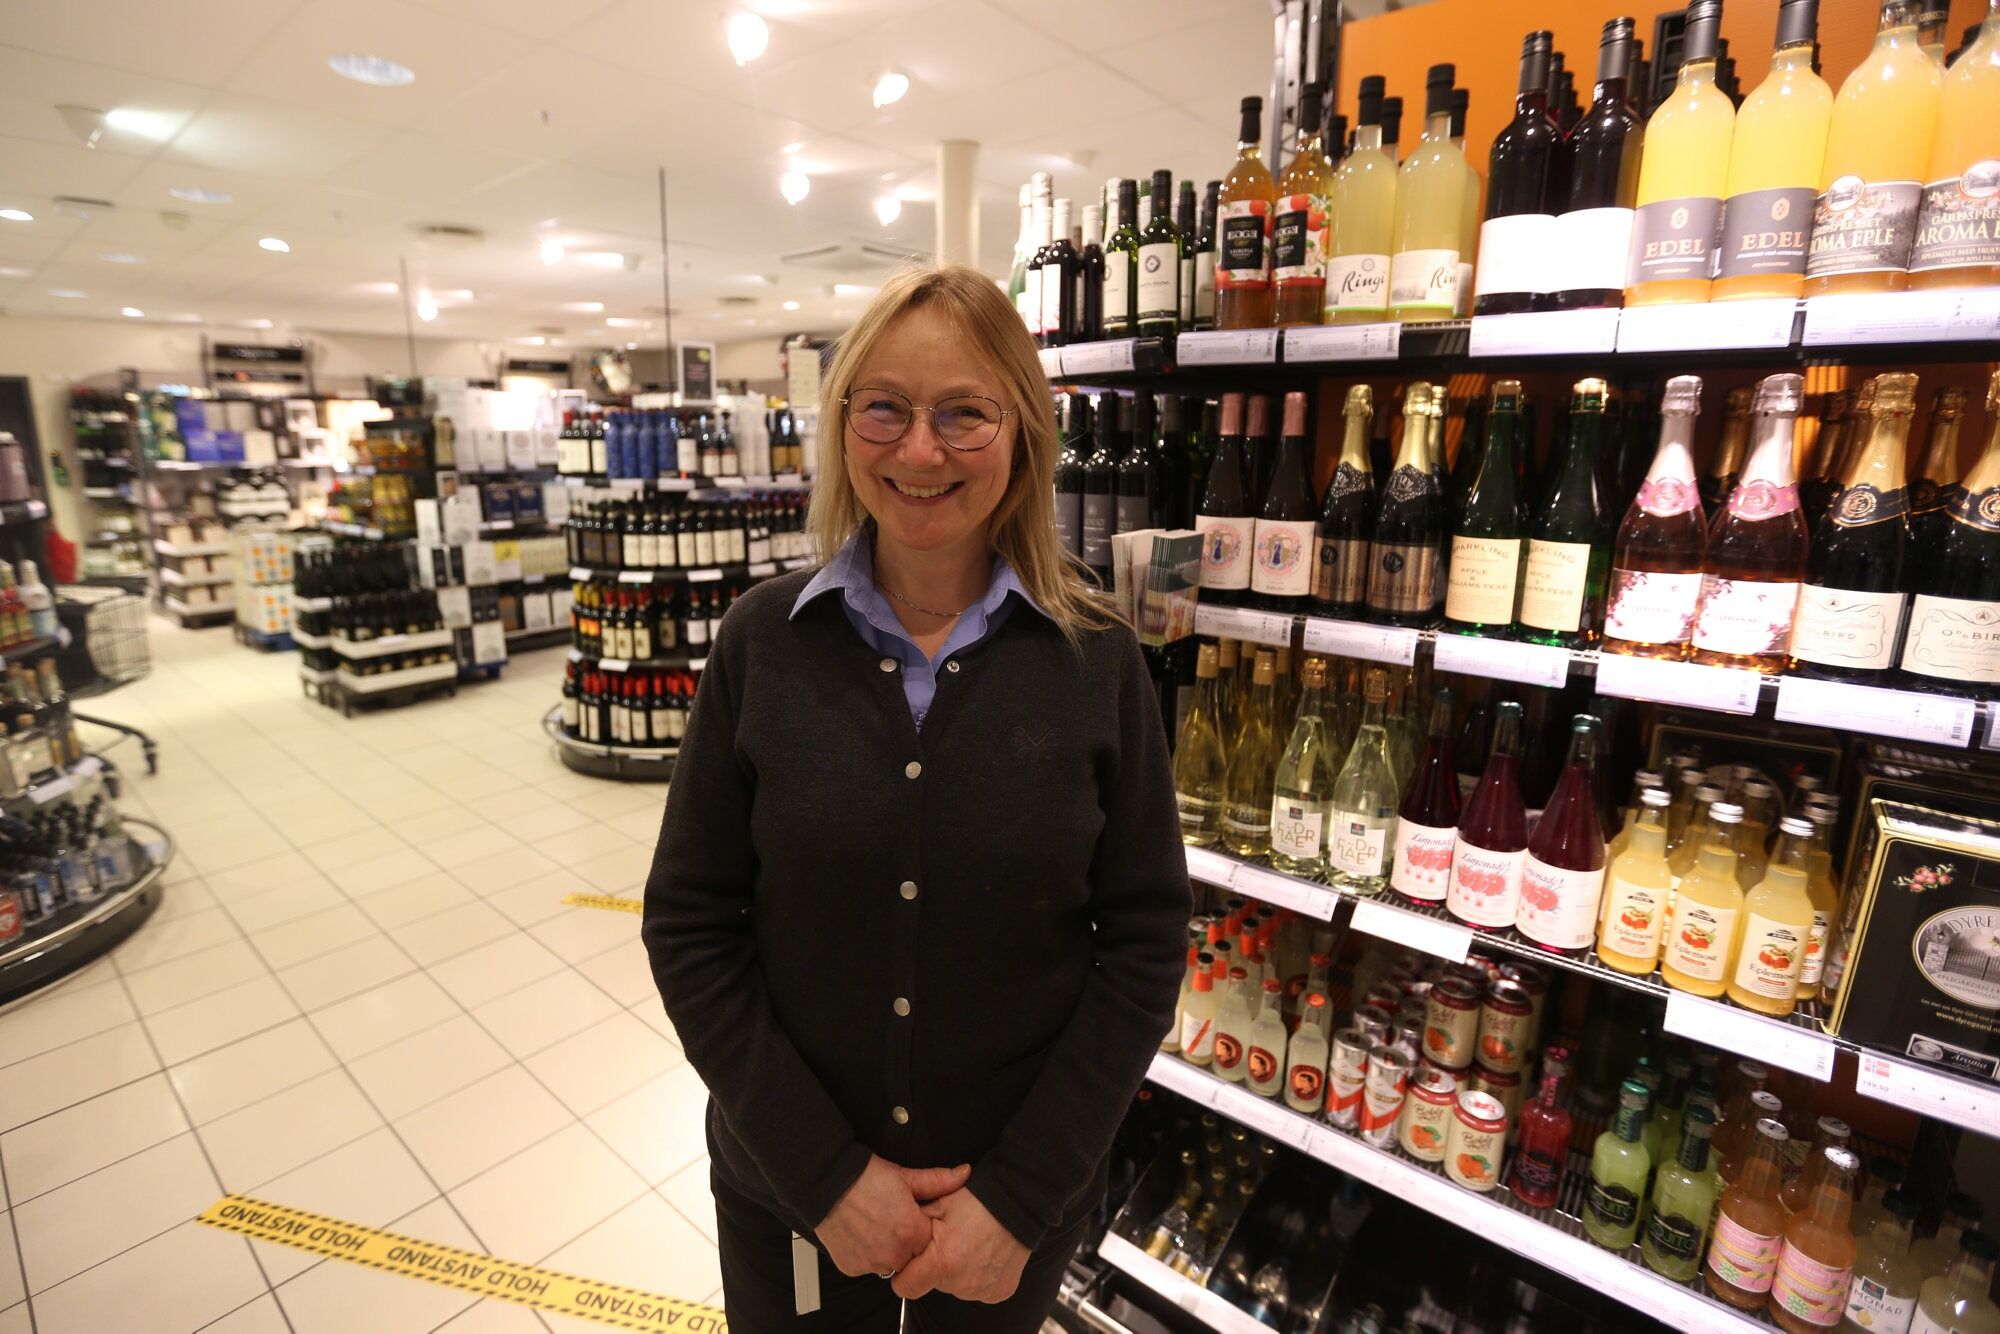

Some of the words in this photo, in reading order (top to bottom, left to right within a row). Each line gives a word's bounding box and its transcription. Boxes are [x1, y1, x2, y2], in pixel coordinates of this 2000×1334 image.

[1740, 231, 1804, 251] EDEL
[1851, 228, 1895, 247] EPLE
[1916, 219, 1988, 247] AROMA
[1643, 238, 1705, 259] EDEL
[1342, 270, 1385, 293] Ringi
[1410, 832, 1454, 847] Limonad
[1947, 915, 1995, 933] DYRE
[219, 1204, 310, 1236] AVSTAND
[309, 1226, 368, 1251] HOLD
[387, 1246, 487, 1279] AVSTAND
[487, 1270, 550, 1296] HOLD
[575, 1290, 683, 1325] AVSTAND
[687, 1315, 728, 1334] OLD
